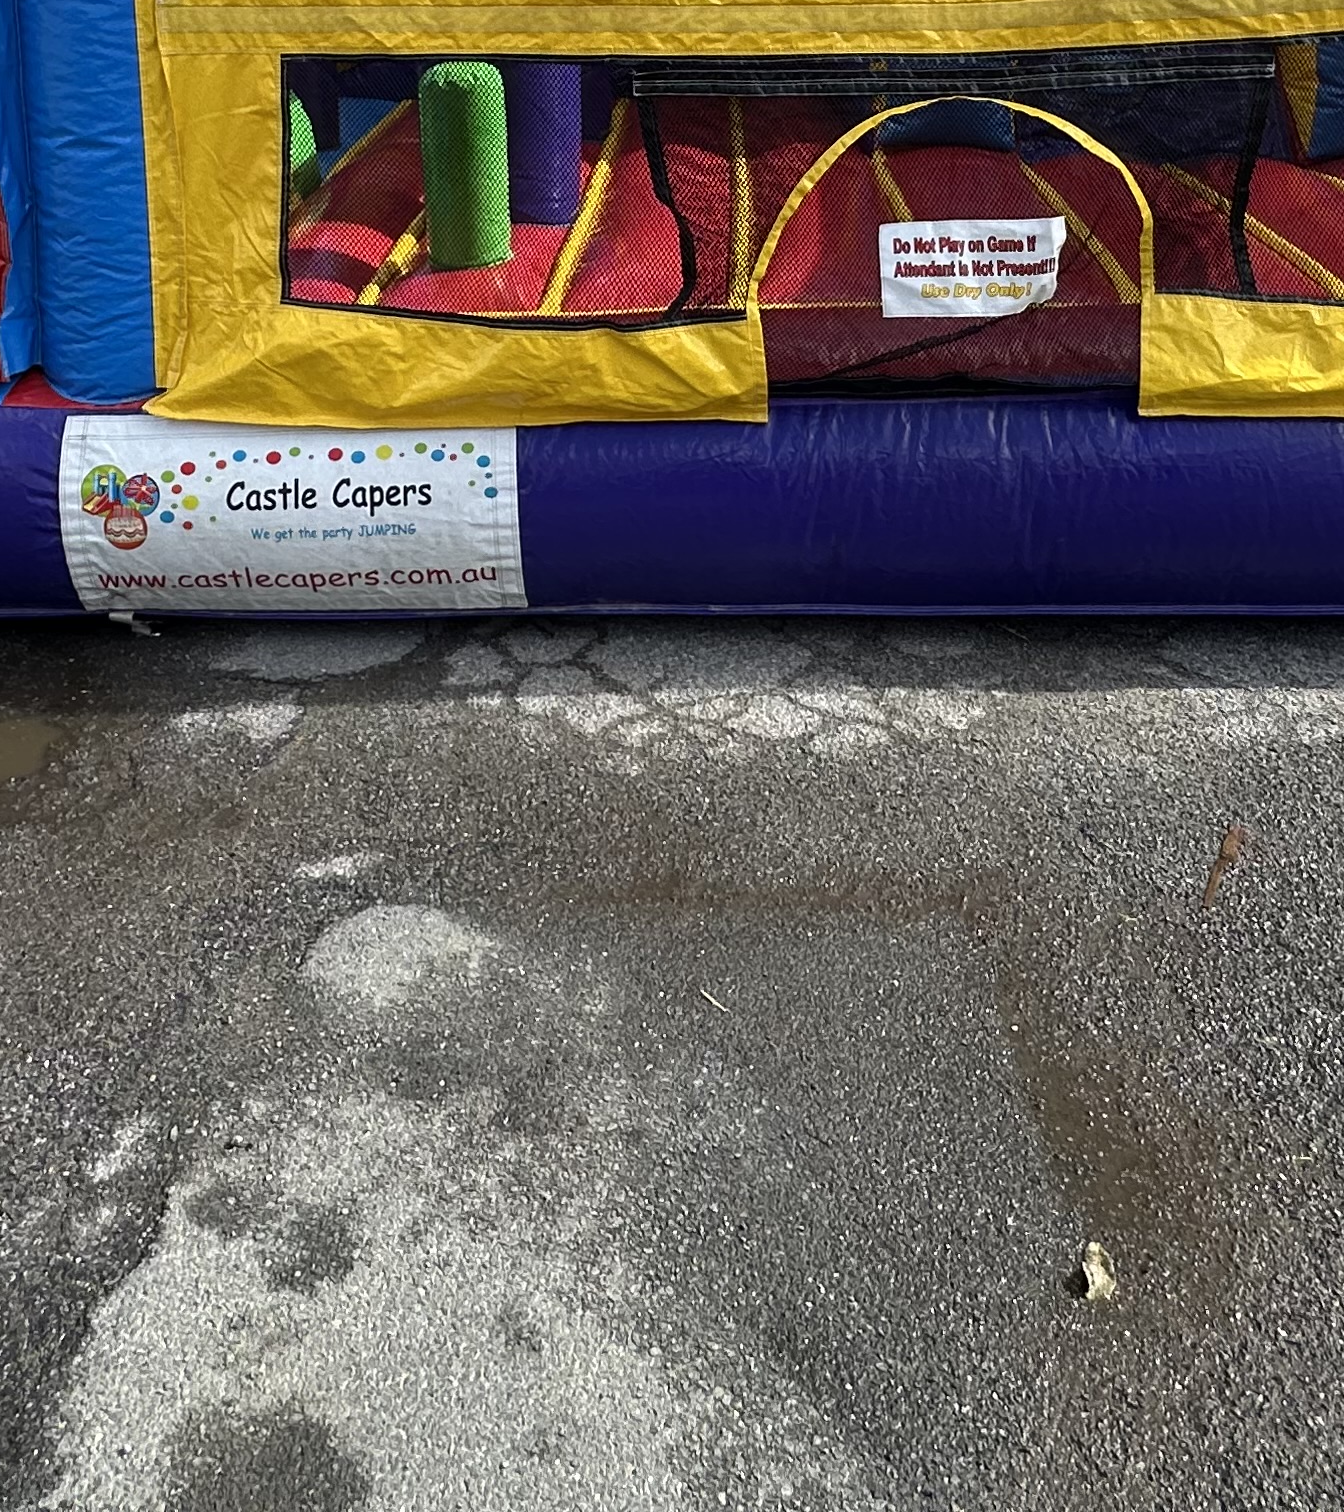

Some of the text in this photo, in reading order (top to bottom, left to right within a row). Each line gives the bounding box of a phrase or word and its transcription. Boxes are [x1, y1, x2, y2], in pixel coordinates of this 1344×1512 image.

[893, 237, 911, 254] Do
[913, 237, 937, 254] Not
[938, 236, 965, 257] Play
[968, 240, 984, 253] on
[987, 235, 1024, 253] Game
[894, 260, 956, 278] Attendant
[972, 260, 994, 276] Not
[921, 283, 950, 299] Use
[953, 282, 982, 300] Dry
[226, 477, 432, 517] Castle Capers
[251, 523, 416, 543] We get the party JUMPING
[98, 566, 497, 592] www.castlecapers.com.au
